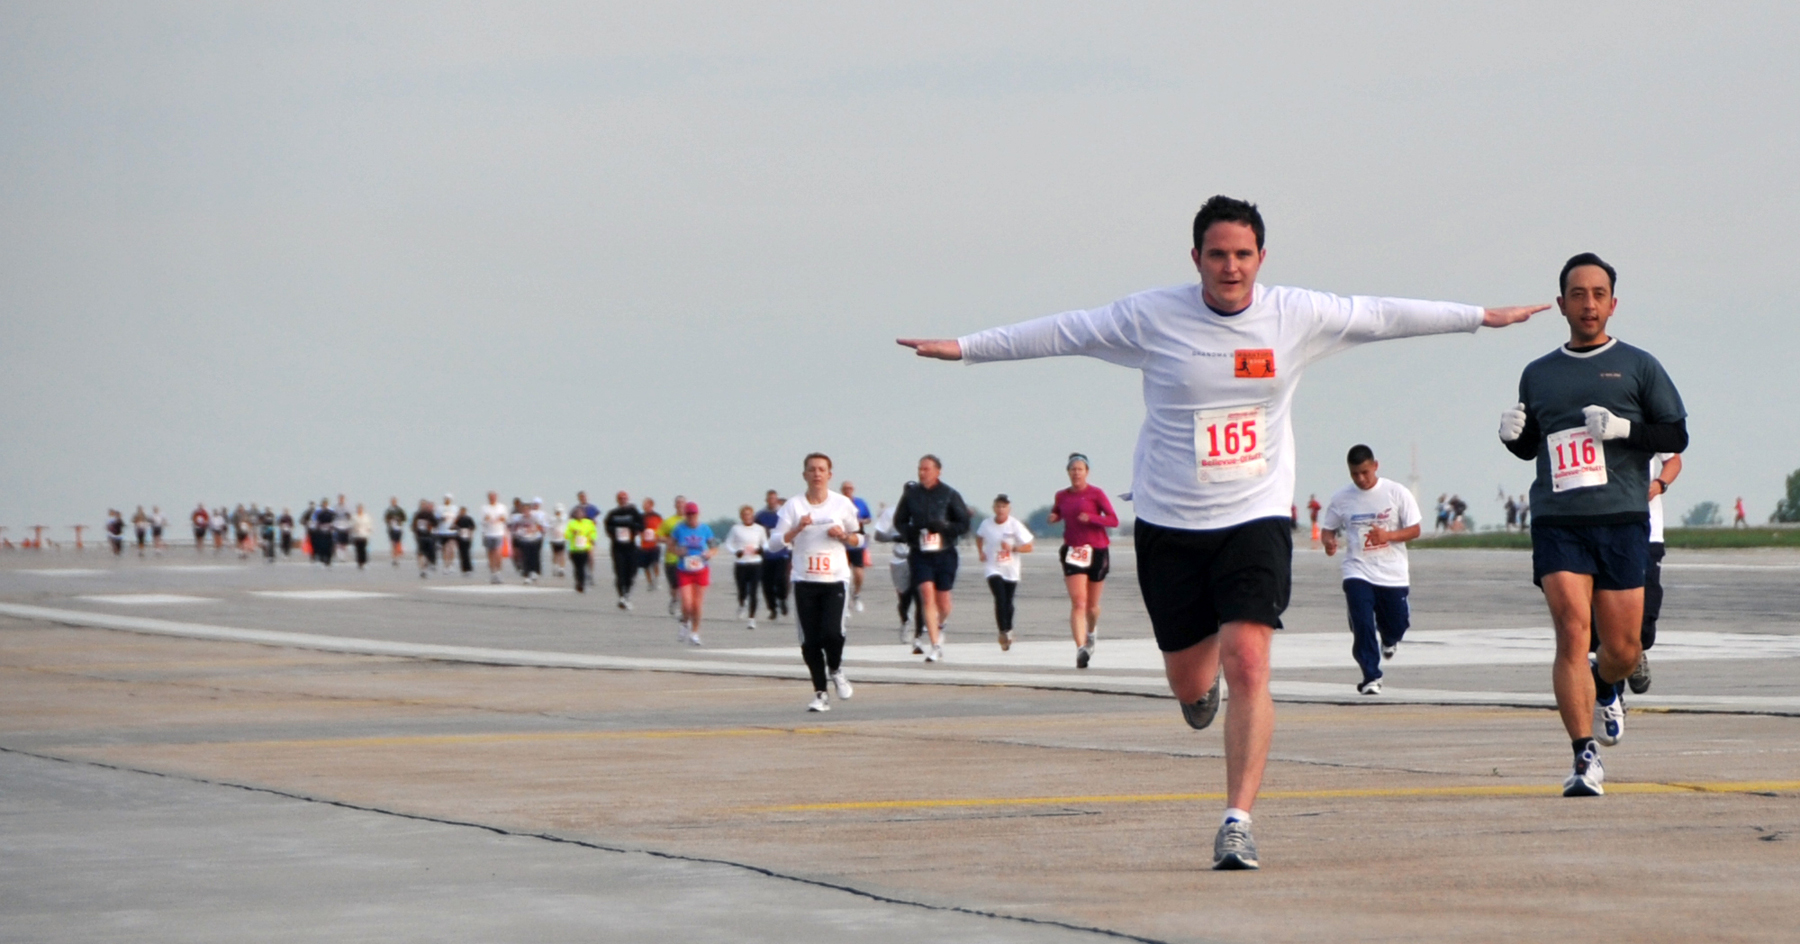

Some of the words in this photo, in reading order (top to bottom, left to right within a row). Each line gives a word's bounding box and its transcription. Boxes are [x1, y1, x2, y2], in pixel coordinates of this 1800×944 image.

[1206, 420, 1256, 456] 165
[1556, 438, 1596, 470] 116
[808, 556, 831, 571] 119
